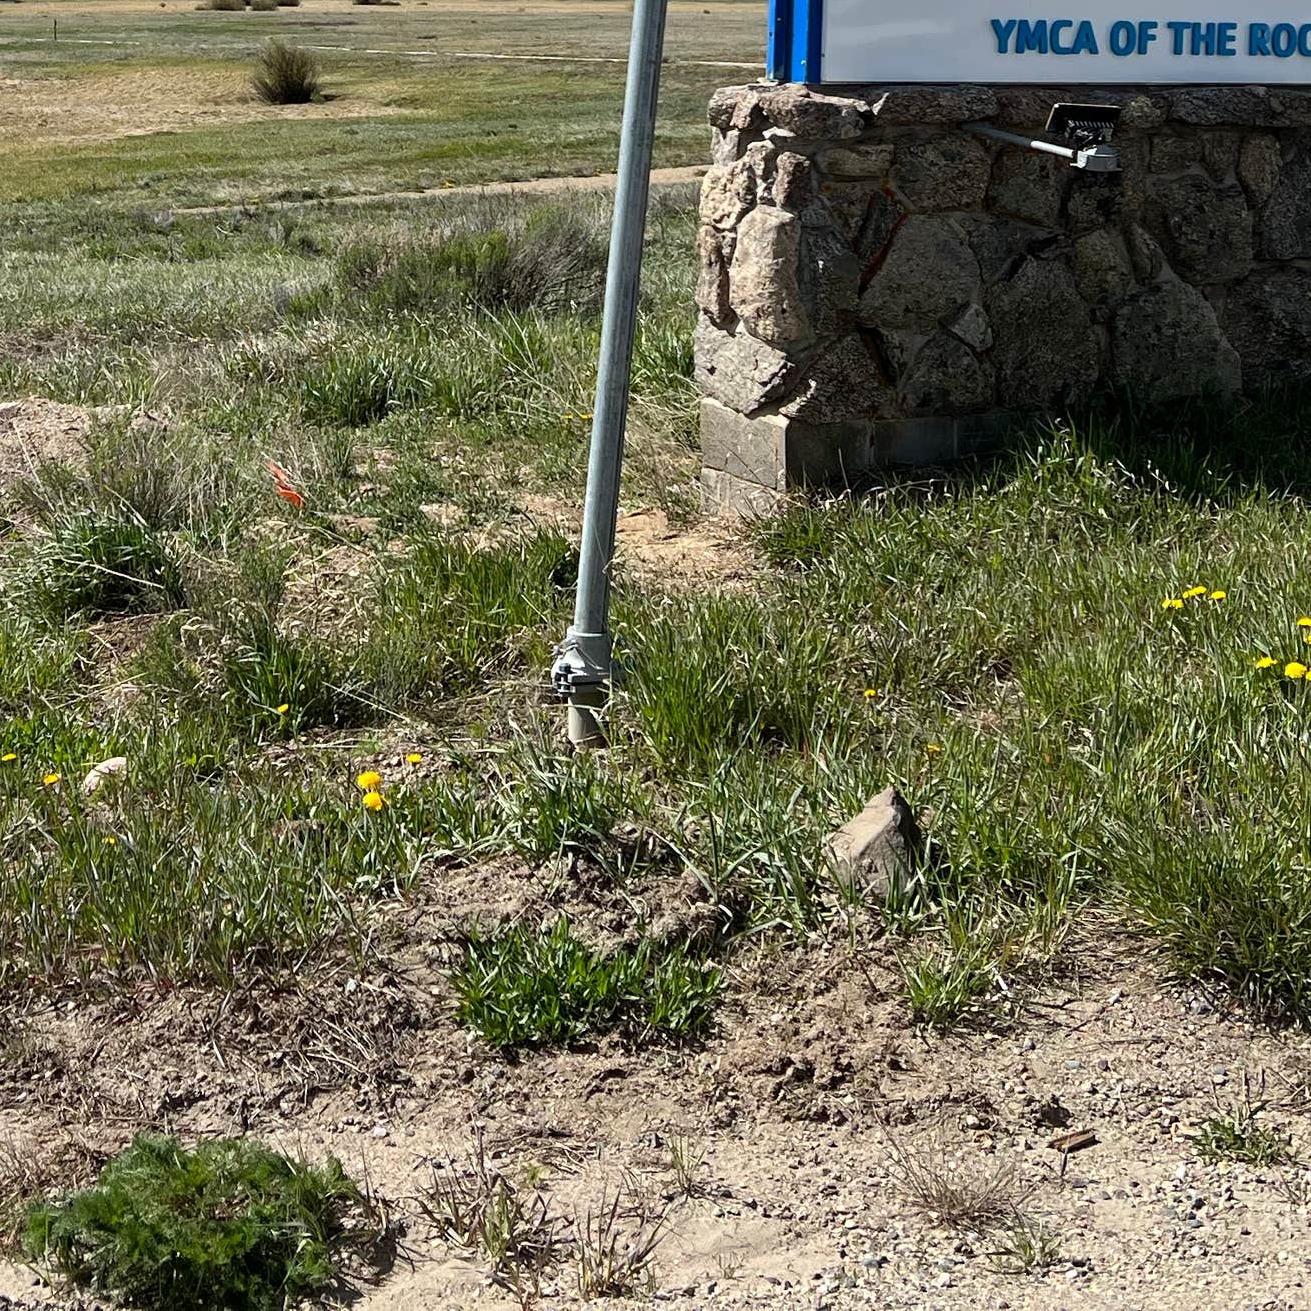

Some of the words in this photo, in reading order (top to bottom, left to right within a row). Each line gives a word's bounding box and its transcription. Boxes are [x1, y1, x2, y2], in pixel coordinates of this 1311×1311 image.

[990, 18, 1099, 56] YMCA
[1109, 20, 1158, 57] OF
[1167, 21, 1238, 57] THE
